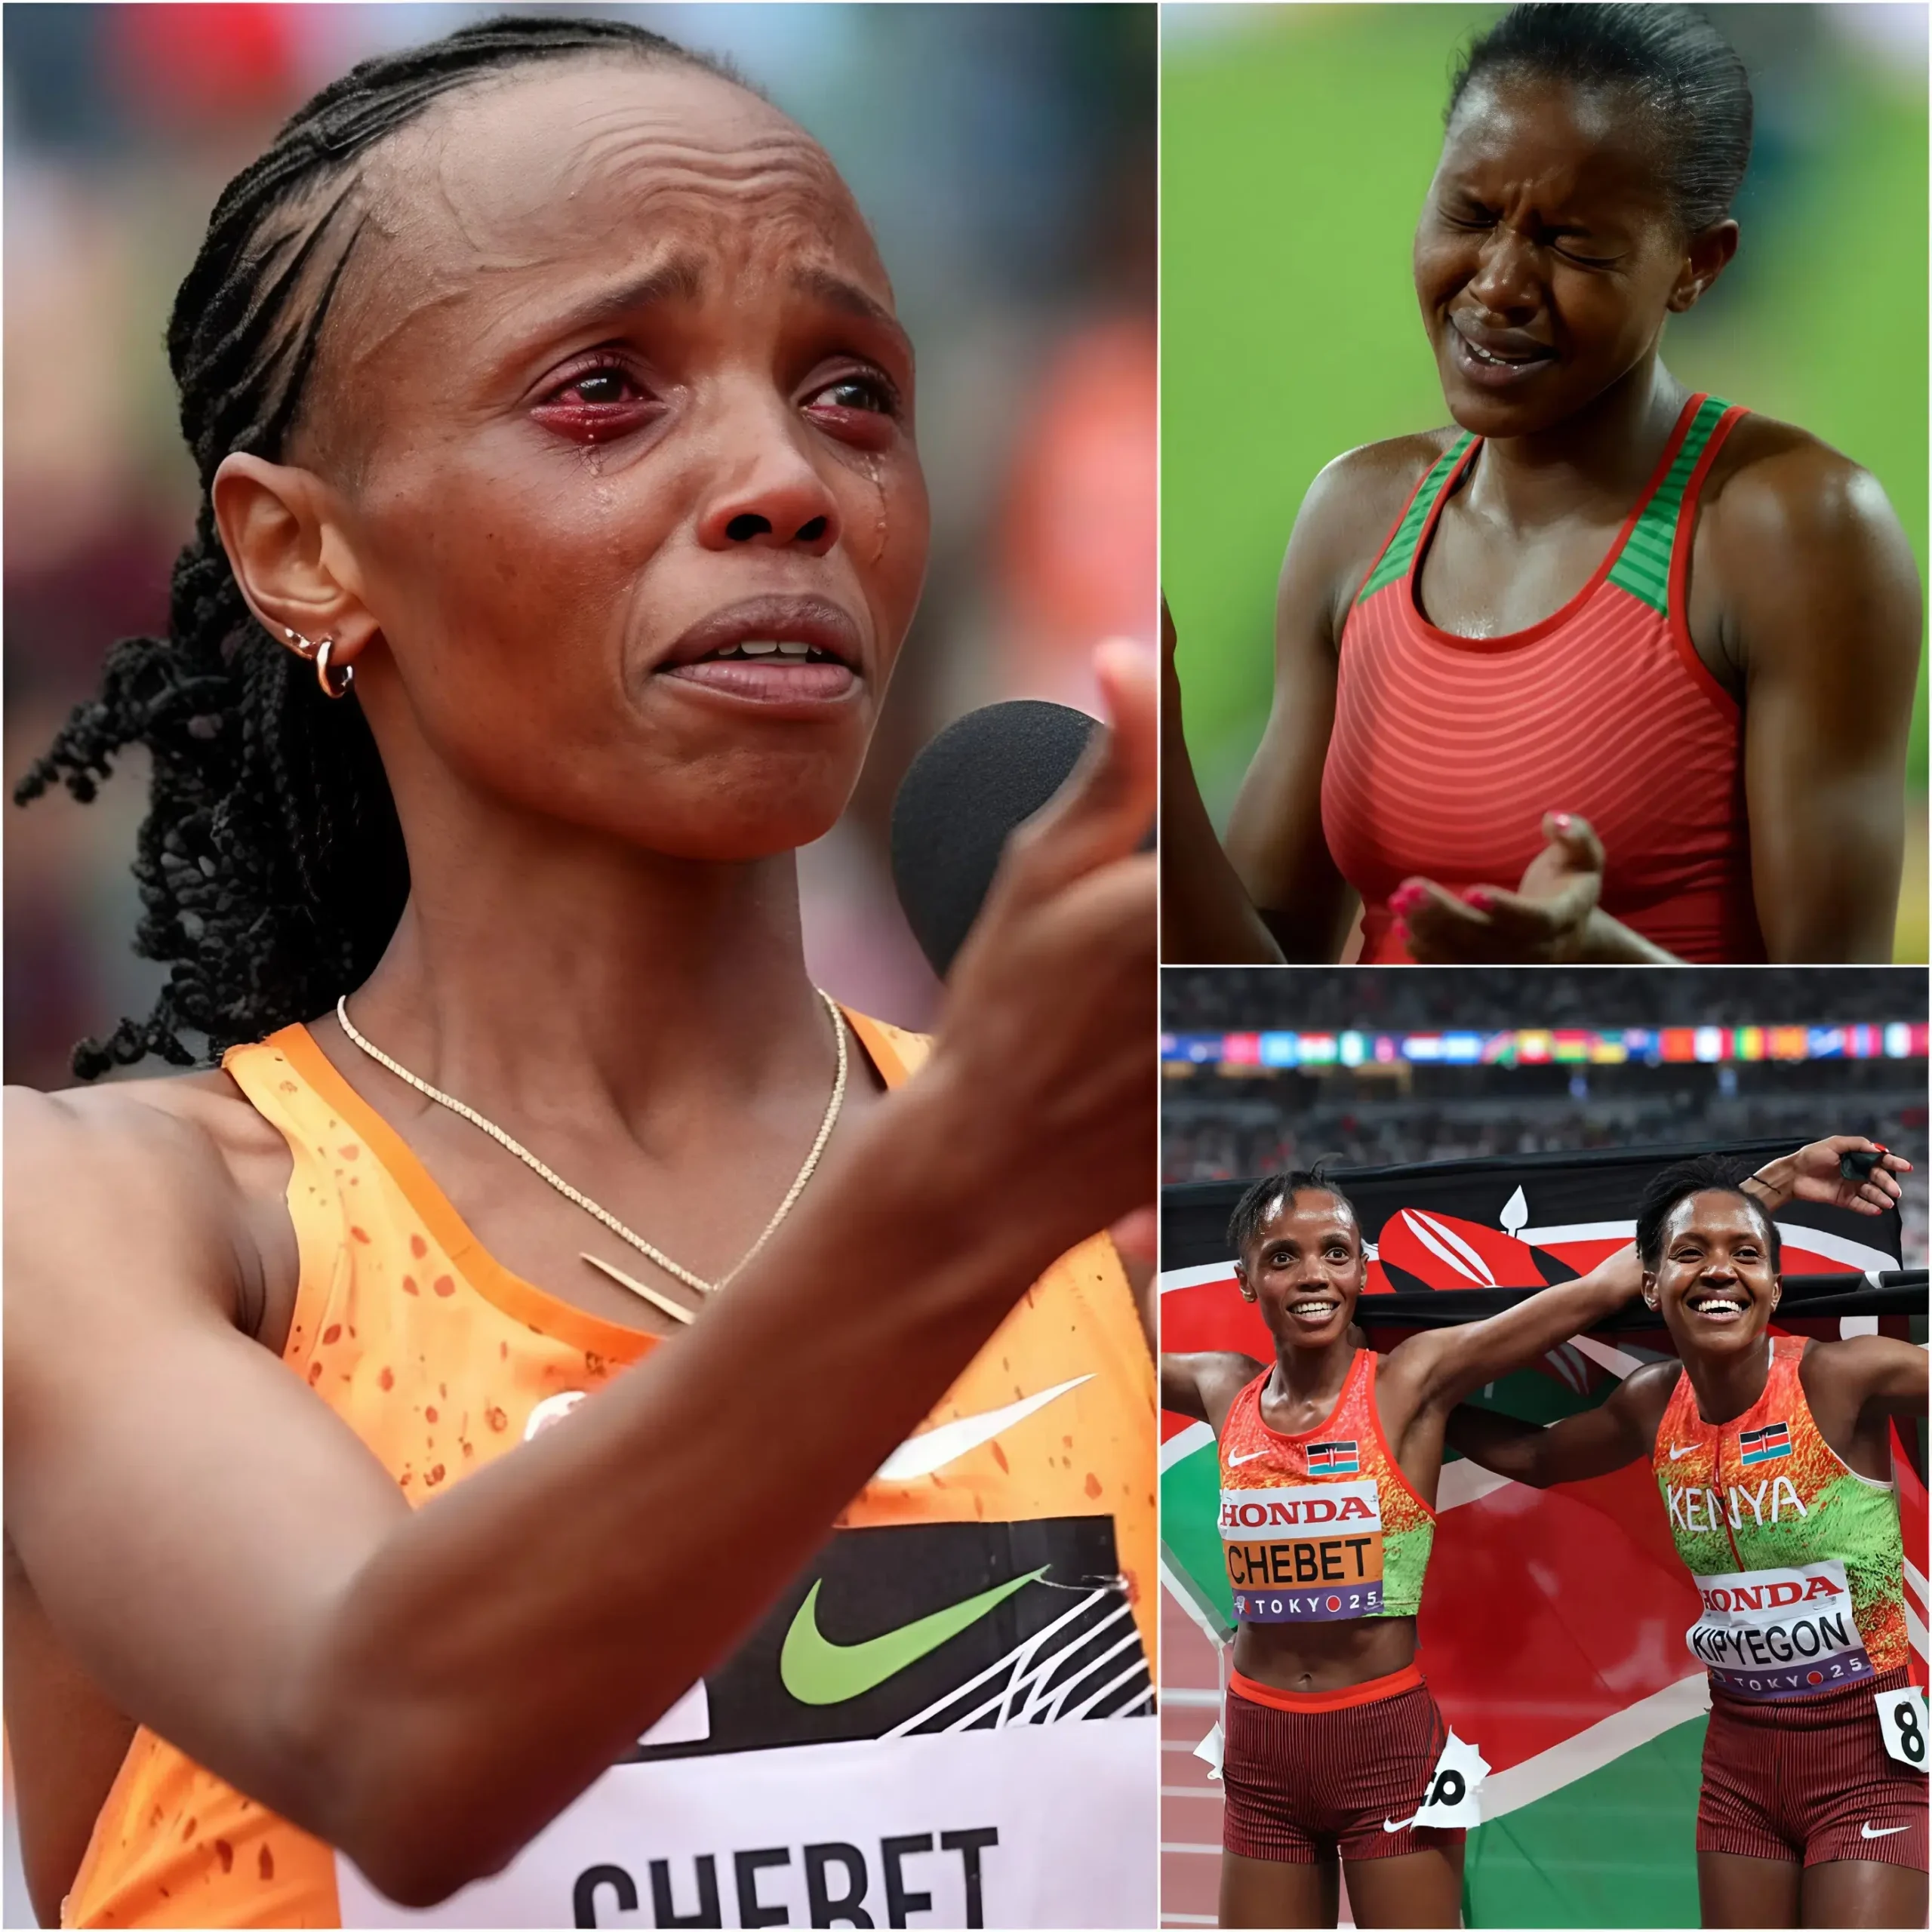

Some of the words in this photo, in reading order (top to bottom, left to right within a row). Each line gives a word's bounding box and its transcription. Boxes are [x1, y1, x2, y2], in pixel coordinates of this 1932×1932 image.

[1220, 1497, 1376, 1527] HONDA
[1666, 1475, 1808, 1531] KENYA
[1228, 1537, 1372, 1585] CHEBET
[1349, 1591, 1377, 1609] 25
[1700, 1576, 1843, 1612] HONDA
[1693, 1614, 1850, 1665] KIPYEGON
[1831, 1657, 1863, 1678] 25
[1894, 1701, 1925, 1763] 8
